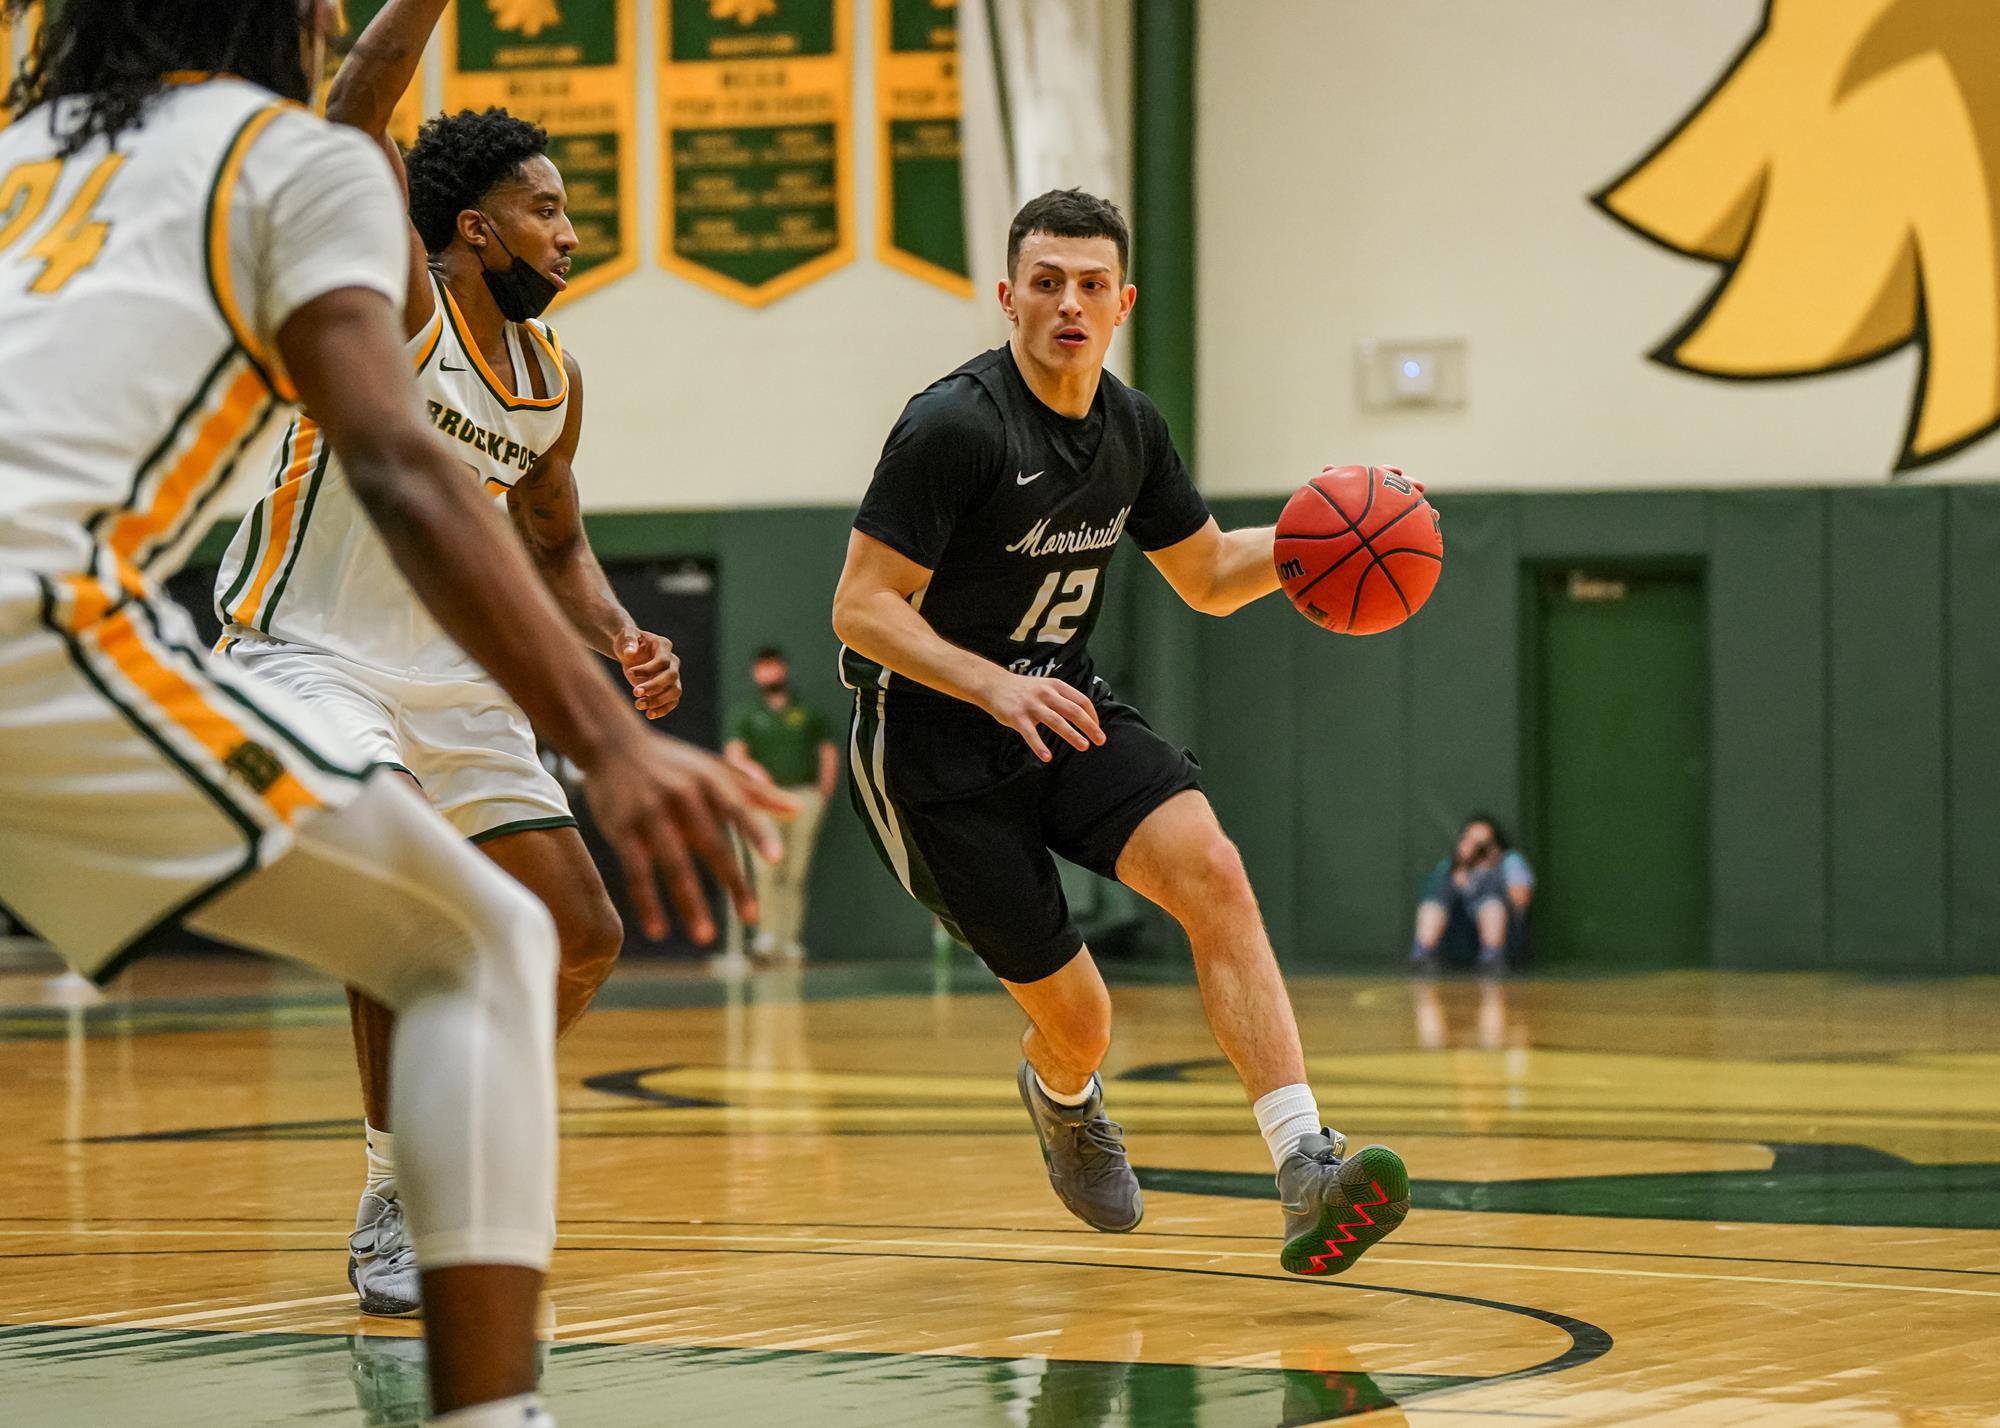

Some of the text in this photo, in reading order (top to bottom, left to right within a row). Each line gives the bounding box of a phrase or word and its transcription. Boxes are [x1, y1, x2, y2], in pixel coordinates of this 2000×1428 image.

[0, 152, 127, 293] 24
[1005, 505, 1132, 557] Morrisvill
[1009, 567, 1099, 645] 12
